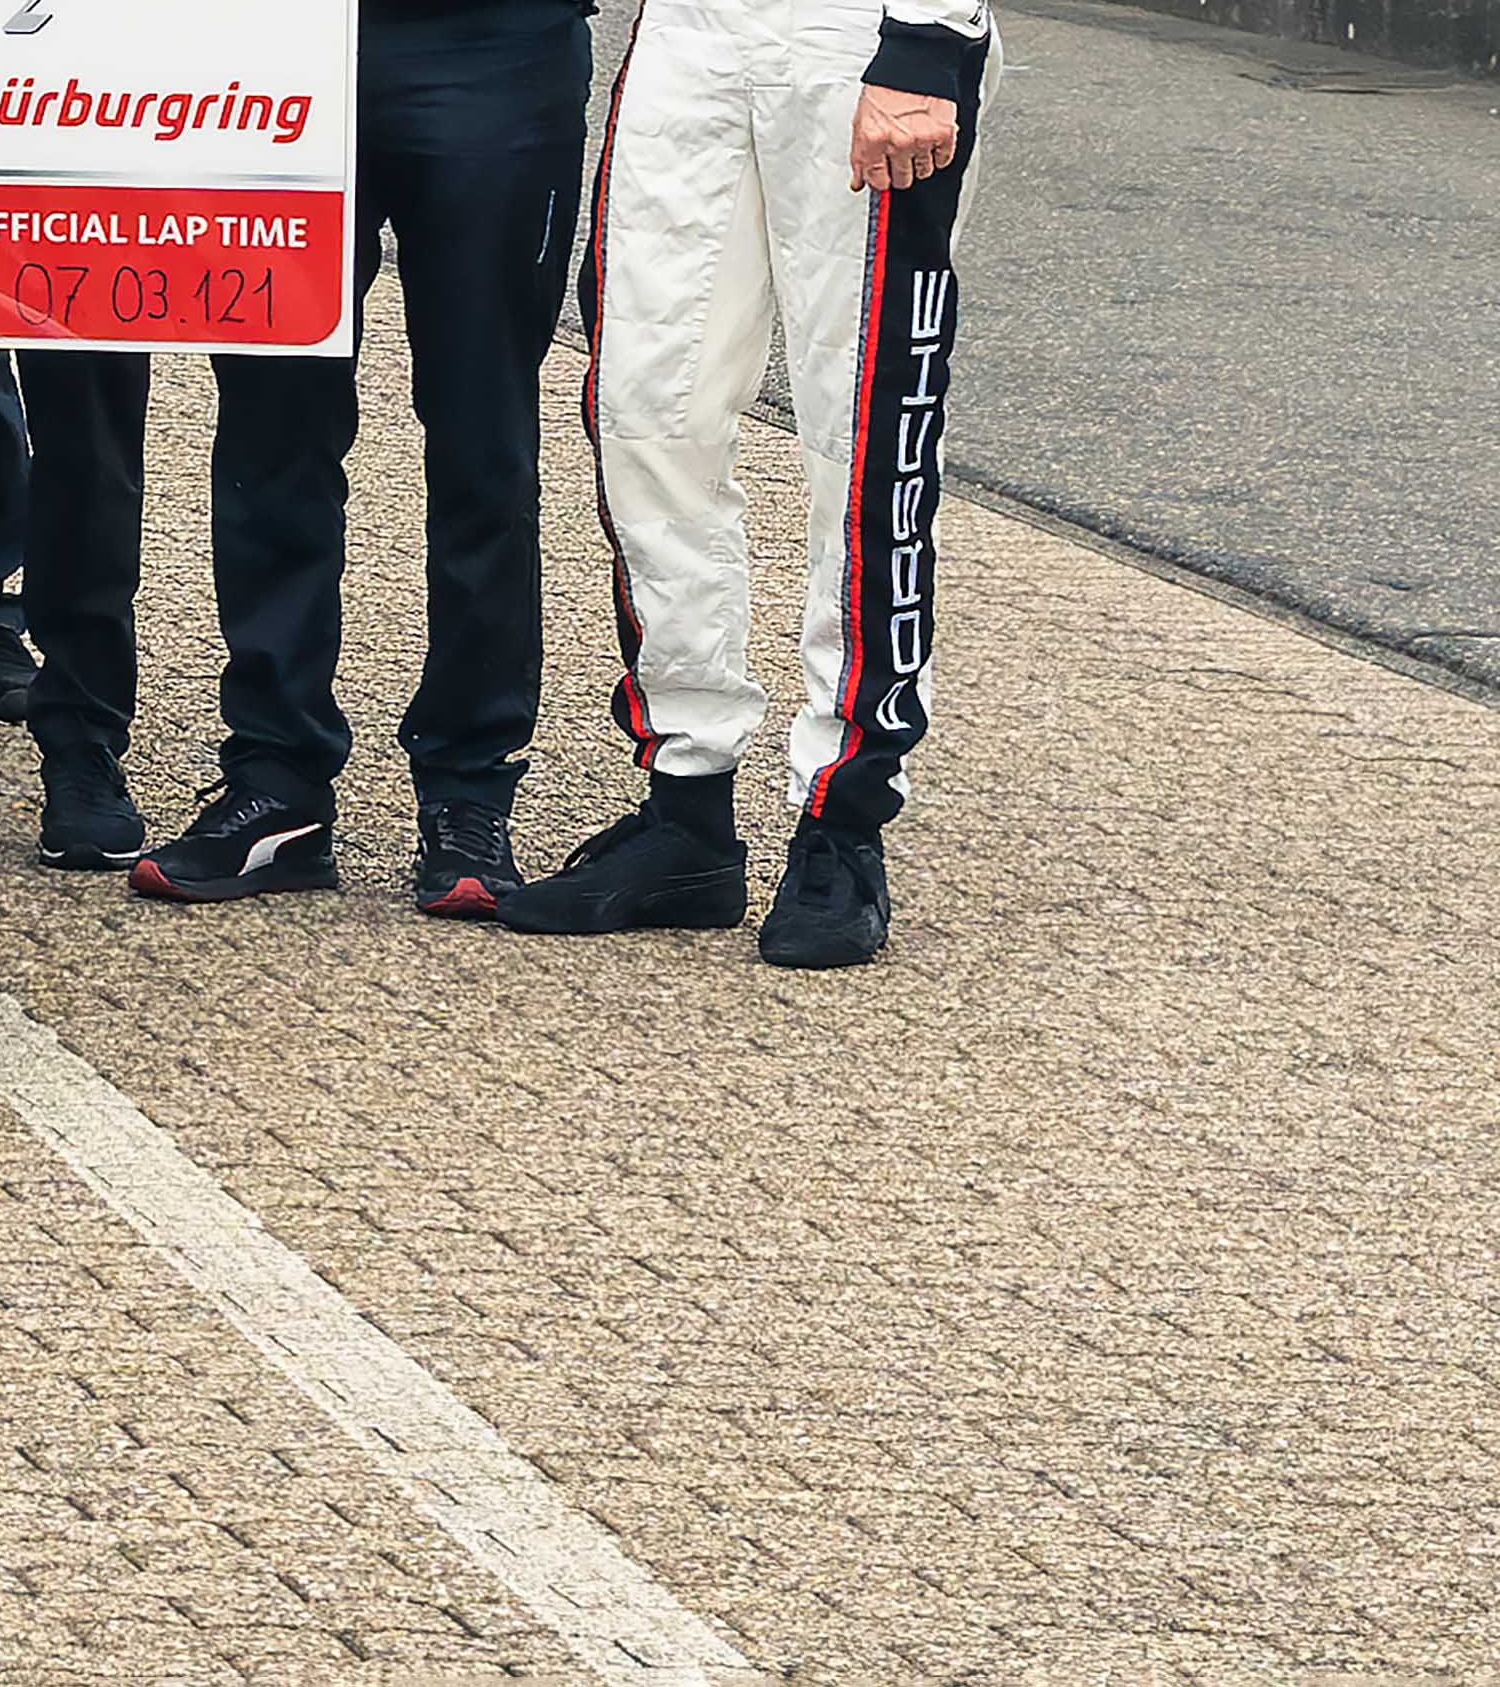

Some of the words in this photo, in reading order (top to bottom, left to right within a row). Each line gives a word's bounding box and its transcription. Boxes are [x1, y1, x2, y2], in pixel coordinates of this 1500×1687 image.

[137, 214, 208, 247] LAP
[215, 216, 308, 248] TIME
[15, 263, 90, 326] 07
[875, 269, 951, 731] PORSCHE
